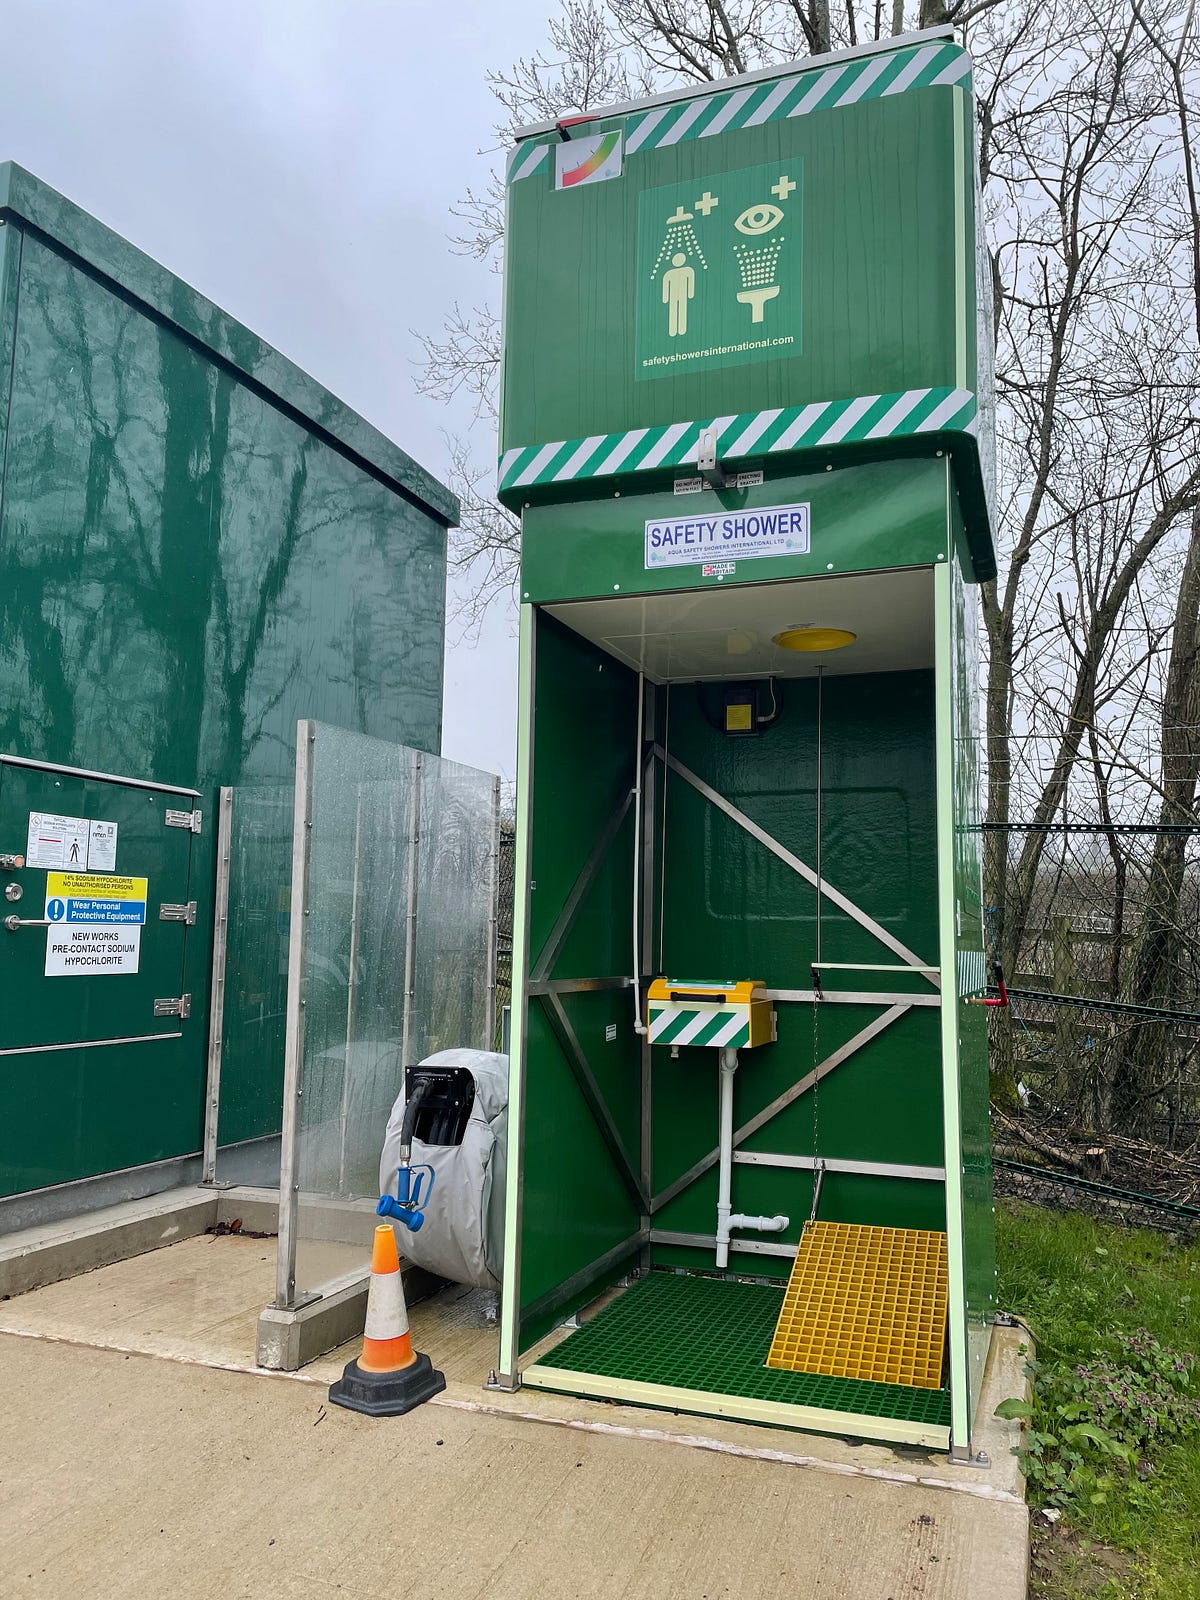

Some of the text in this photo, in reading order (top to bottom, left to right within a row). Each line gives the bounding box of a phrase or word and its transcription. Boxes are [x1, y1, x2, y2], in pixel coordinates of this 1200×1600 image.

[642, 335, 794, 367] safetyshowersinternational.com
[651, 512, 803, 548] SAFETY SHOWER
[731, 541, 773, 549] INTERNATIONAL
[72, 881, 110, 889] UNAUTHORISED
[72, 901, 120, 910] Wear Personal
[71, 911, 140, 921] Protective Equipment
[72, 932, 119, 941] NEW WORKS
[52, 944, 135, 953] PRE-CONTACT SODIUM
[64, 956, 123, 965] HYPOCHLORITE
